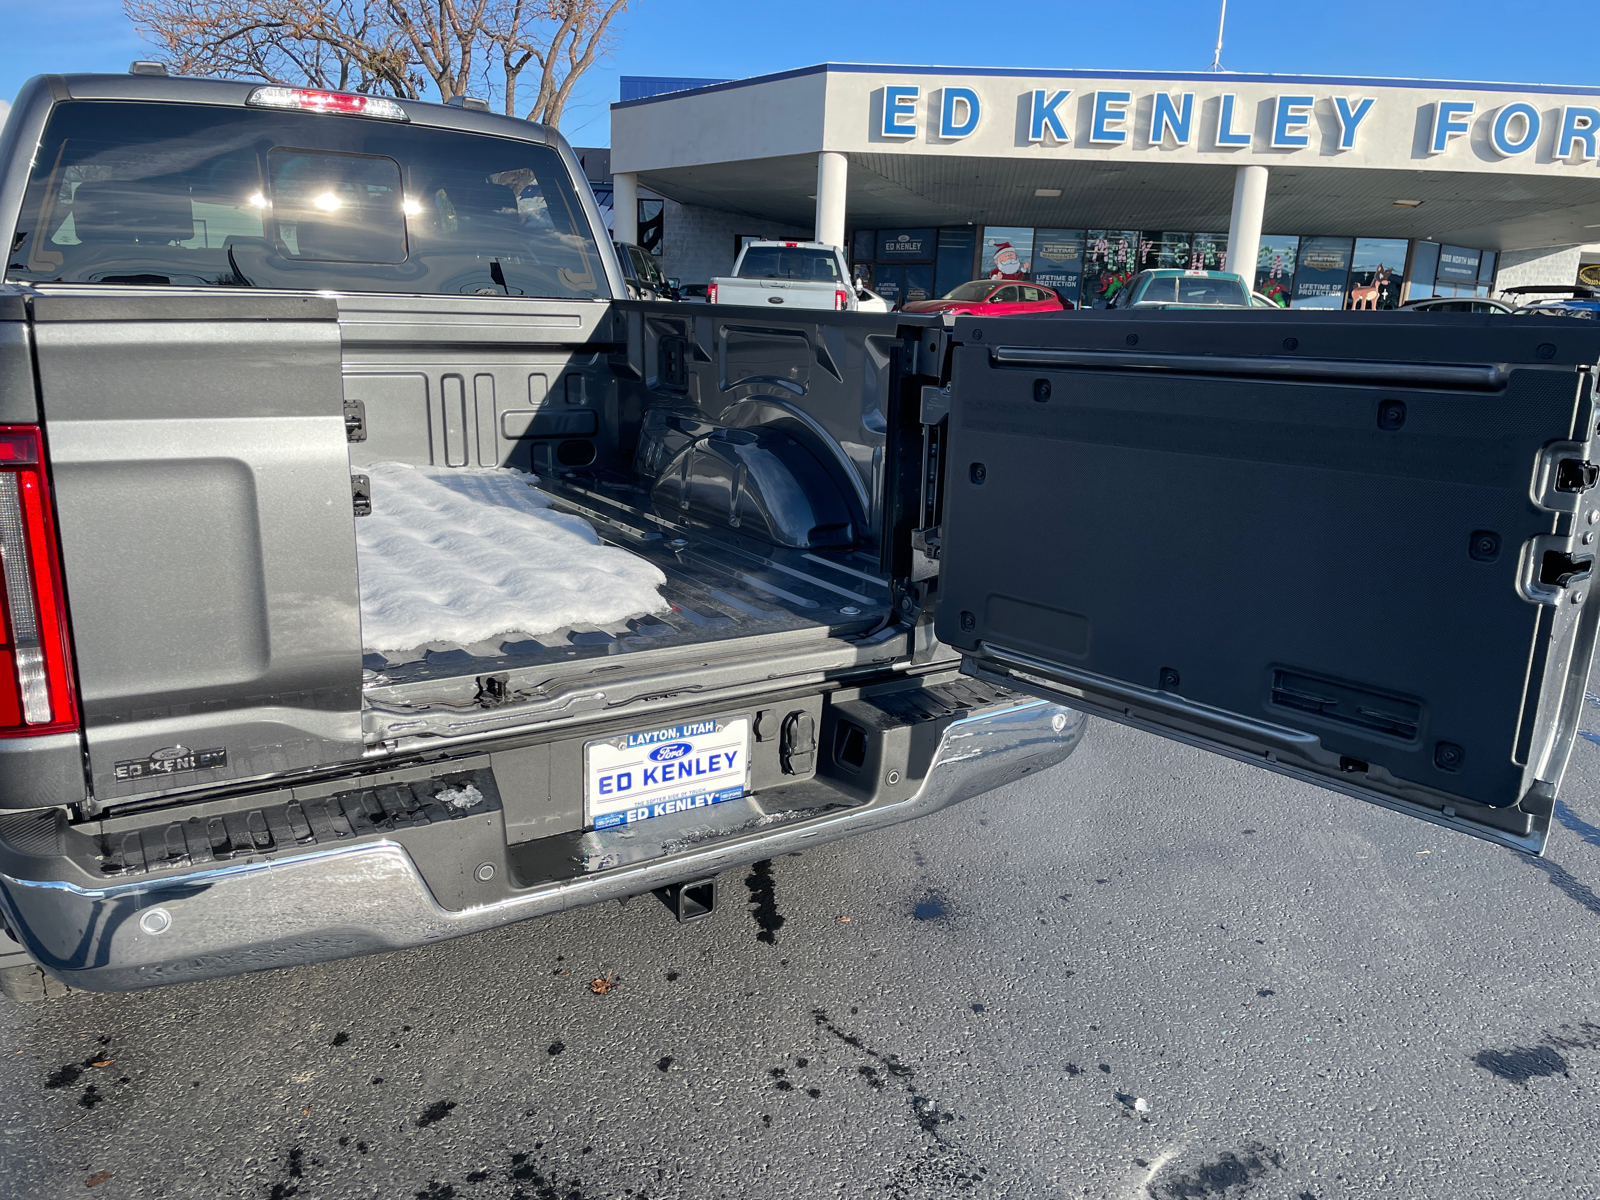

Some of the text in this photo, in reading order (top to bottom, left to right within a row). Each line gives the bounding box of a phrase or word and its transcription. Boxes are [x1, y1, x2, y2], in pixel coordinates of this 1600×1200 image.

[881, 84, 982, 139] ED
[1028, 88, 1378, 150] KENLEY
[885, 242, 922, 251] ED KENLEY
[1298, 289, 1342, 297] PROTECTION
[629, 721, 714, 746] LAYTON, UTAH
[656, 745, 685, 761] Ford
[116, 764, 142, 778] ED
[598, 751, 738, 795] ED KENLEY
[626, 792, 715, 823] ED KENLEY
